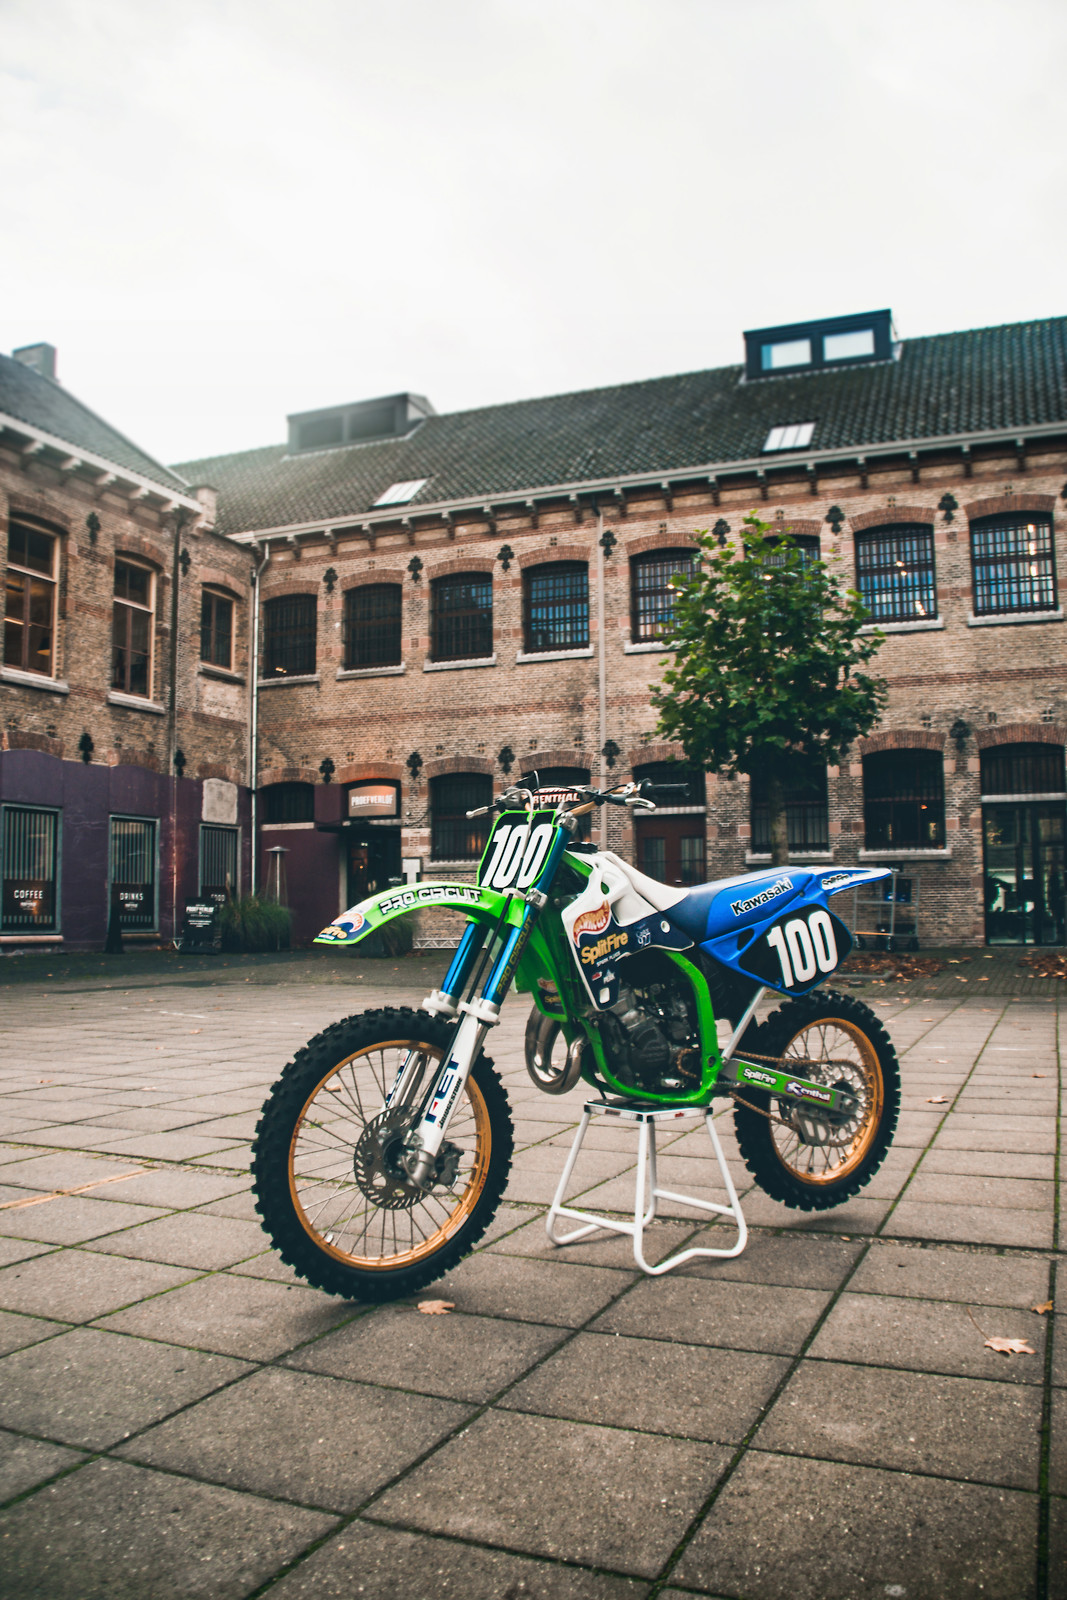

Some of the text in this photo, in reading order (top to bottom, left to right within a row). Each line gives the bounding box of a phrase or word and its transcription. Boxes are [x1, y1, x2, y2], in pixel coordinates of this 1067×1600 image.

[532, 793, 580, 804] RENTHAL
[480, 823, 554, 889] 100
[13, 889, 44, 899] COFFEE
[119, 892, 144, 901] DRINKS
[379, 886, 481, 915] PRO CIRCUIT
[730, 877, 794, 917] Kawasaki
[496, 914, 533, 994] PRO CIRCUIT
[581, 932, 629, 965] SplitFire
[766, 910, 839, 989] 100
[742, 1068, 778, 1085] SplitFire
